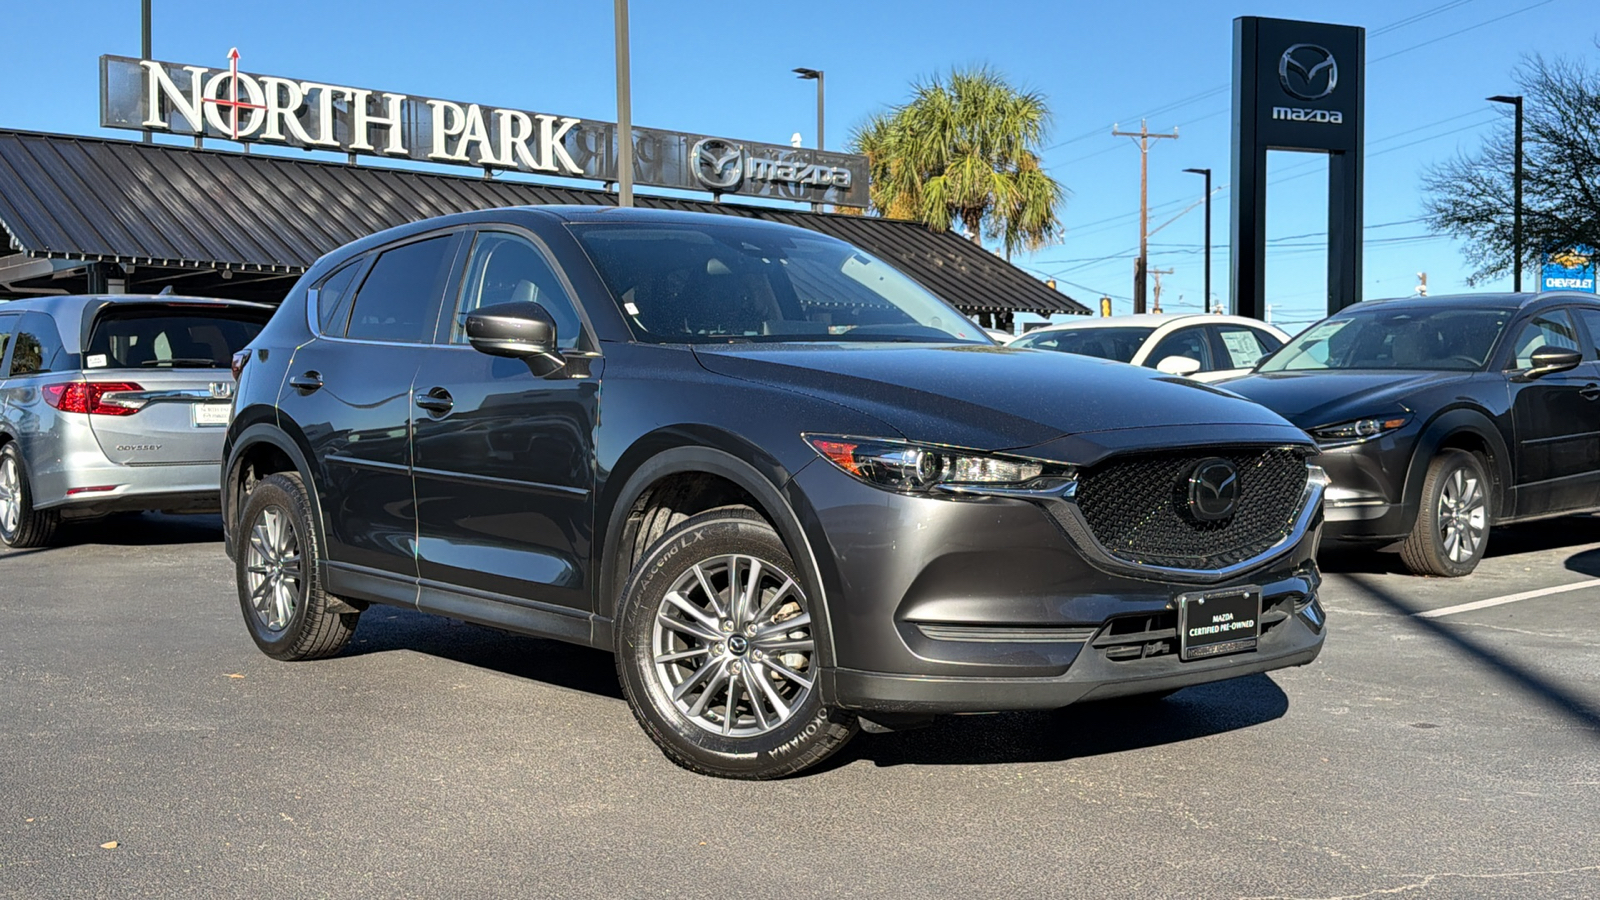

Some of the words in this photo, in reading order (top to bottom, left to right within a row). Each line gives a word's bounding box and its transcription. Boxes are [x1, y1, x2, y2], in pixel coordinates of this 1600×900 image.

[140, 60, 407, 154] NORTH
[427, 99, 585, 174] PARK
[1272, 106, 1343, 124] mazda
[745, 156, 852, 189] mazda
[1189, 625, 1220, 637] CERTIFIED
[1220, 620, 1254, 632] PRE-OWNED
[1212, 613, 1233, 622] MAZDA
[768, 707, 828, 760] OKOHAMA
